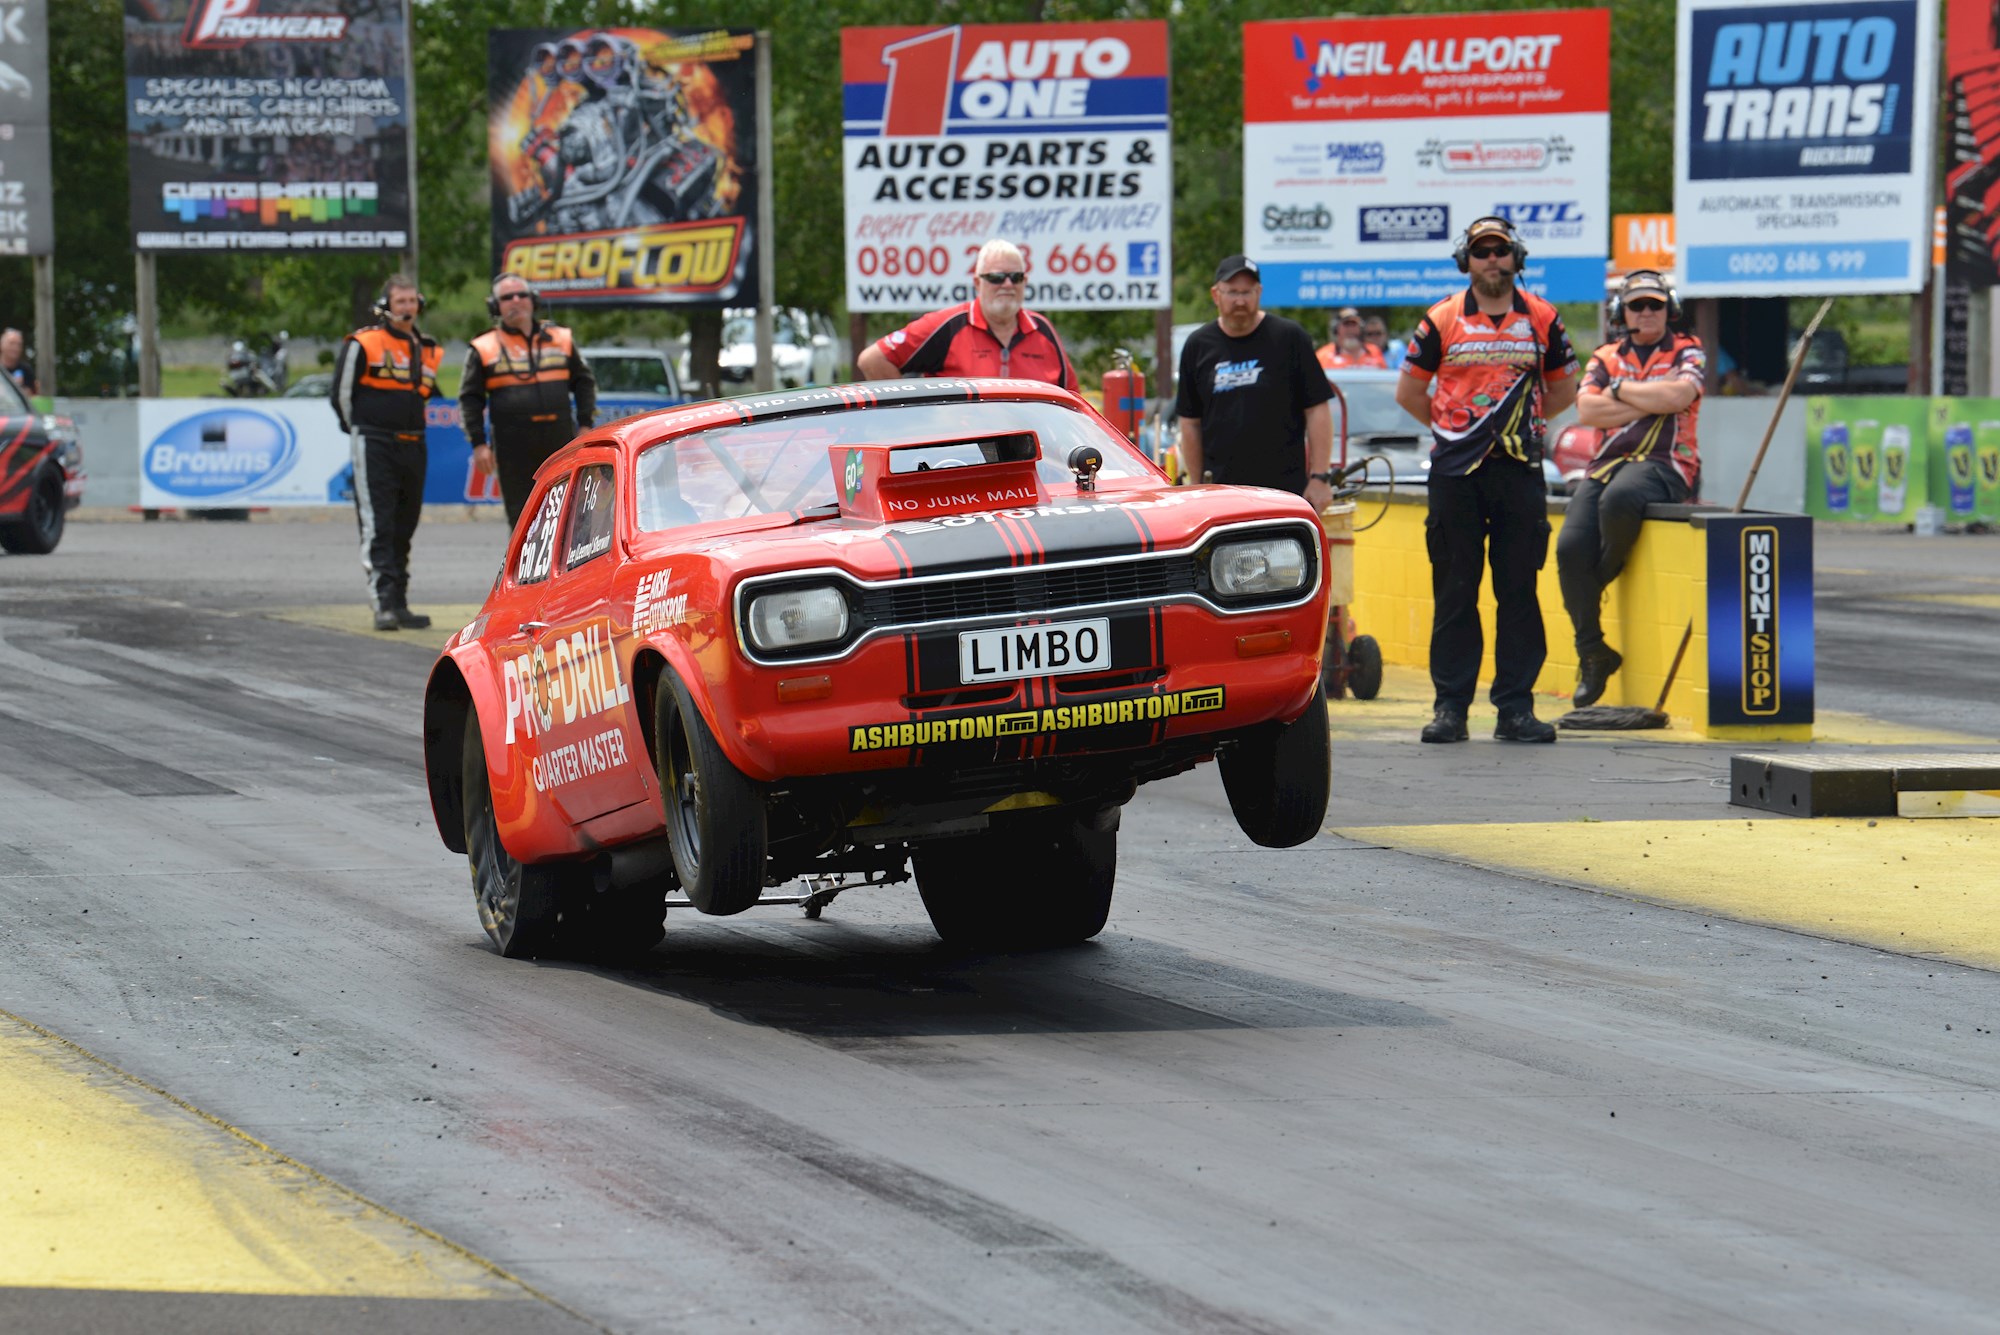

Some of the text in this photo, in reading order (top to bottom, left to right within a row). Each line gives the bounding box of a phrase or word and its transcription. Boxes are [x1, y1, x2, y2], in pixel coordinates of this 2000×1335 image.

[961, 37, 1130, 80] AUTO
[1315, 34, 1562, 77] NEIL ALLPORT
[1707, 16, 1897, 87] AUTO
[145, 78, 282, 98] SPECIALISTS
[304, 78, 390, 98] CUSTOM
[960, 78, 1091, 119] ONE
[183, 117, 227, 135] AND
[229, 117, 293, 135] TEAM
[1703, 84, 1887, 142] TRANS
[857, 138, 1155, 170] AUTO PARTS &
[163, 182, 258, 200] CUSTOM
[260, 182, 344, 200] SHIRTS
[875, 172, 1141, 203] ACCESSORIES
[1698, 191, 1902, 214] AUTOMATIC TRANSMISSION
[997, 206, 1071, 239] RIGHT
[1755, 213, 1839, 230] SPECIALISTS
[506, 226, 737, 288] AEROFLOW
[857, 245, 950, 277] 0800
[1046, 242, 1117, 275] 666
[1727, 250, 1868, 275] 0800 686 999
[664, 384, 917, 427] FORWARD-THINKING
[924, 379, 1043, 390] LOGISTICS
[150, 445, 272, 473] Browns
[845, 462, 857, 490] GO
[888, 488, 1037, 511] NO JUNK MAIL
[534, 518, 559, 578] 23
[1749, 533, 1771, 633] MOUNT
[970, 626, 1099, 676] LIMBO
[1750, 633, 1772, 707] SHOP
[851, 714, 994, 752] ASHBURTON
[1041, 693, 1180, 732] ASHBURTON
[532, 727, 629, 793] QUARTER MASTER
